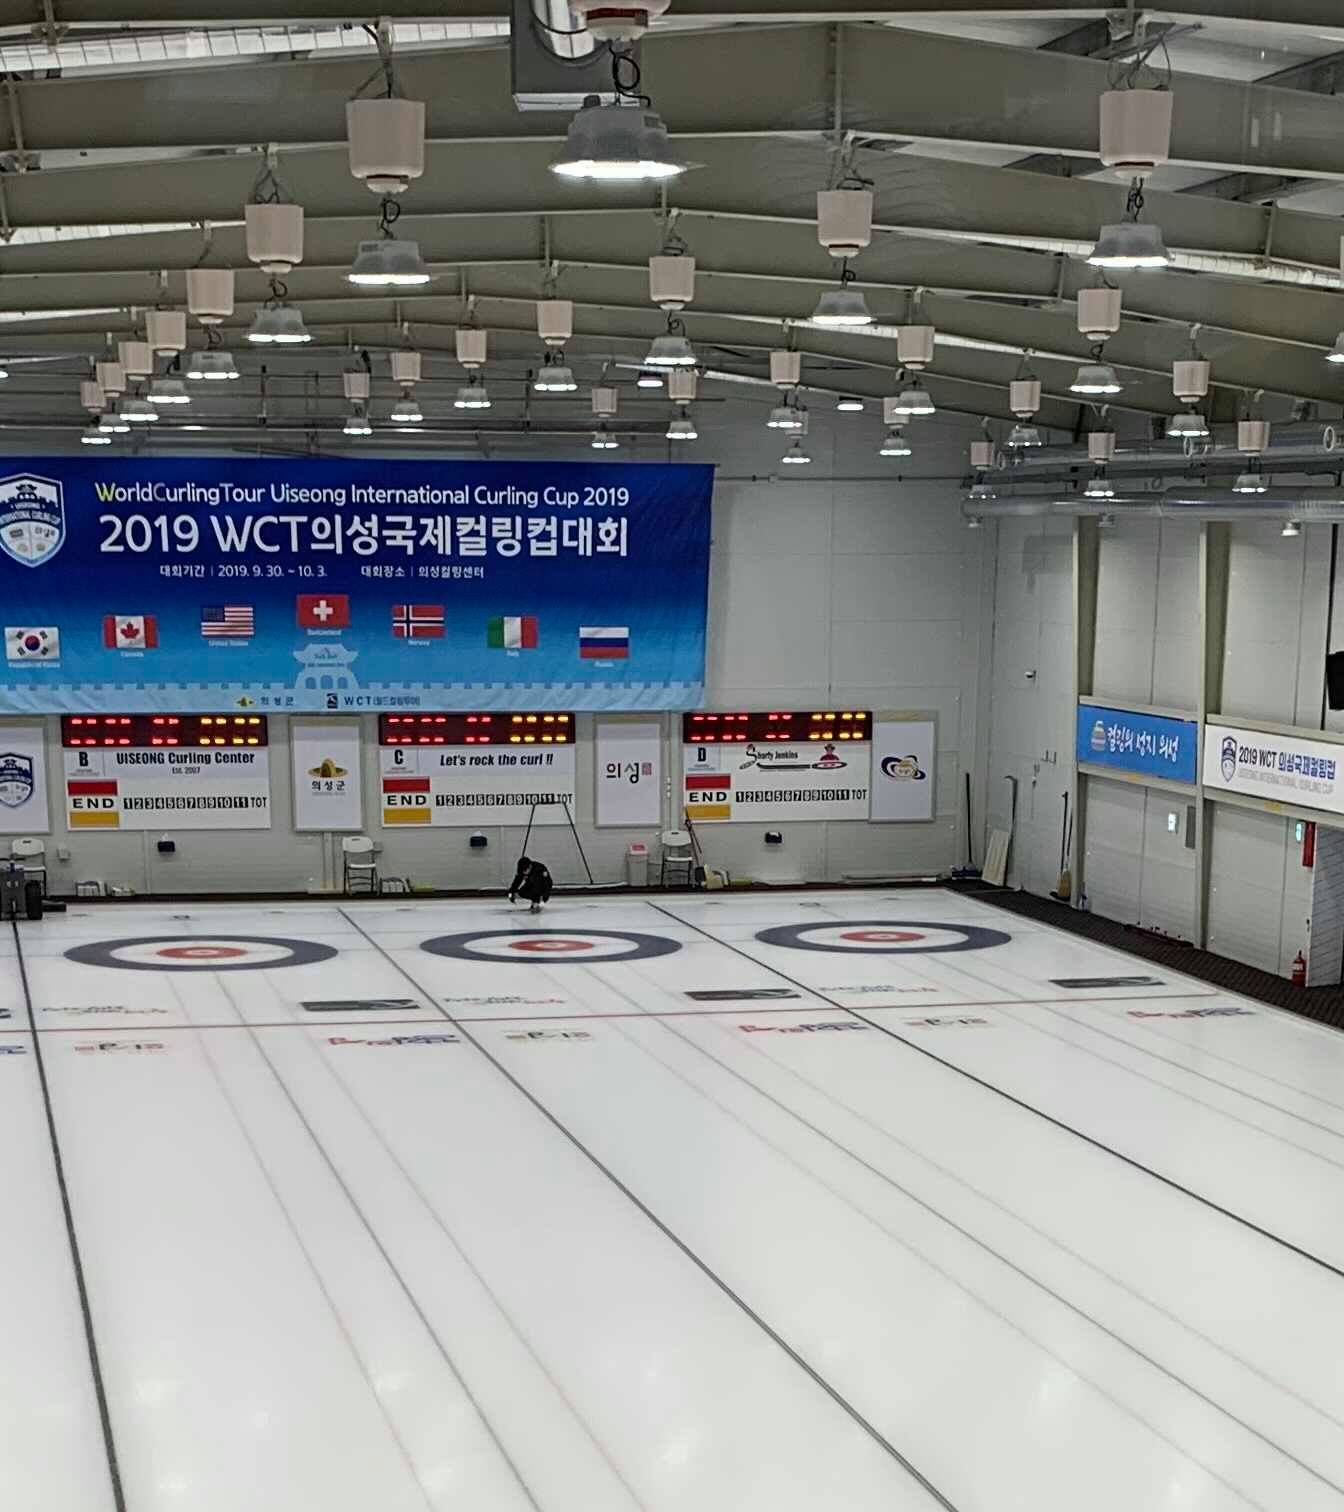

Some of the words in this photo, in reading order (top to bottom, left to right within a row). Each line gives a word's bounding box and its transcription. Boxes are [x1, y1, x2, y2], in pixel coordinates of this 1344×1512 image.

[271, 483, 346, 506] Uiseong
[351, 485, 469, 506] International
[474, 486, 538, 508] Curling
[543, 487, 579, 508] Cup
[583, 487, 630, 506] 2019
[99, 514, 199, 553] 2019
[160, 564, 205, 578] 대회기간
[218, 565, 249, 577] 2019.
[361, 565, 405, 578] 대회장소
[418, 566, 484, 579] 의성컬링센터
[78, 751, 89, 767] B
[116, 752, 165, 765] UISEONG
[168, 752, 212, 766] Curling
[214, 752, 255, 764] Center
[394, 749, 404, 764] C
[440, 754, 466, 767] Let's
[469, 754, 494, 766] rock
[497, 754, 517, 765] the
[520, 754, 543, 765] curl
[697, 747, 707, 762] D
[1239, 746, 1258, 765] 2019
[1259, 750, 1278, 768] WCT
[606, 762, 640, 784] 의성
[311, 780, 345, 791] 의성군
[72, 797, 115, 809] END
[219, 798, 231, 808] 10
[235, 798, 247, 807] 11
[251, 797, 267, 808] TOT
[386, 794, 427, 806] END
[542, 794, 554, 803] 11
[689, 791, 727, 803] END
[822, 791, 834, 800] 10
[837, 790, 848, 799] 11
[852, 790, 866, 800] TOT
